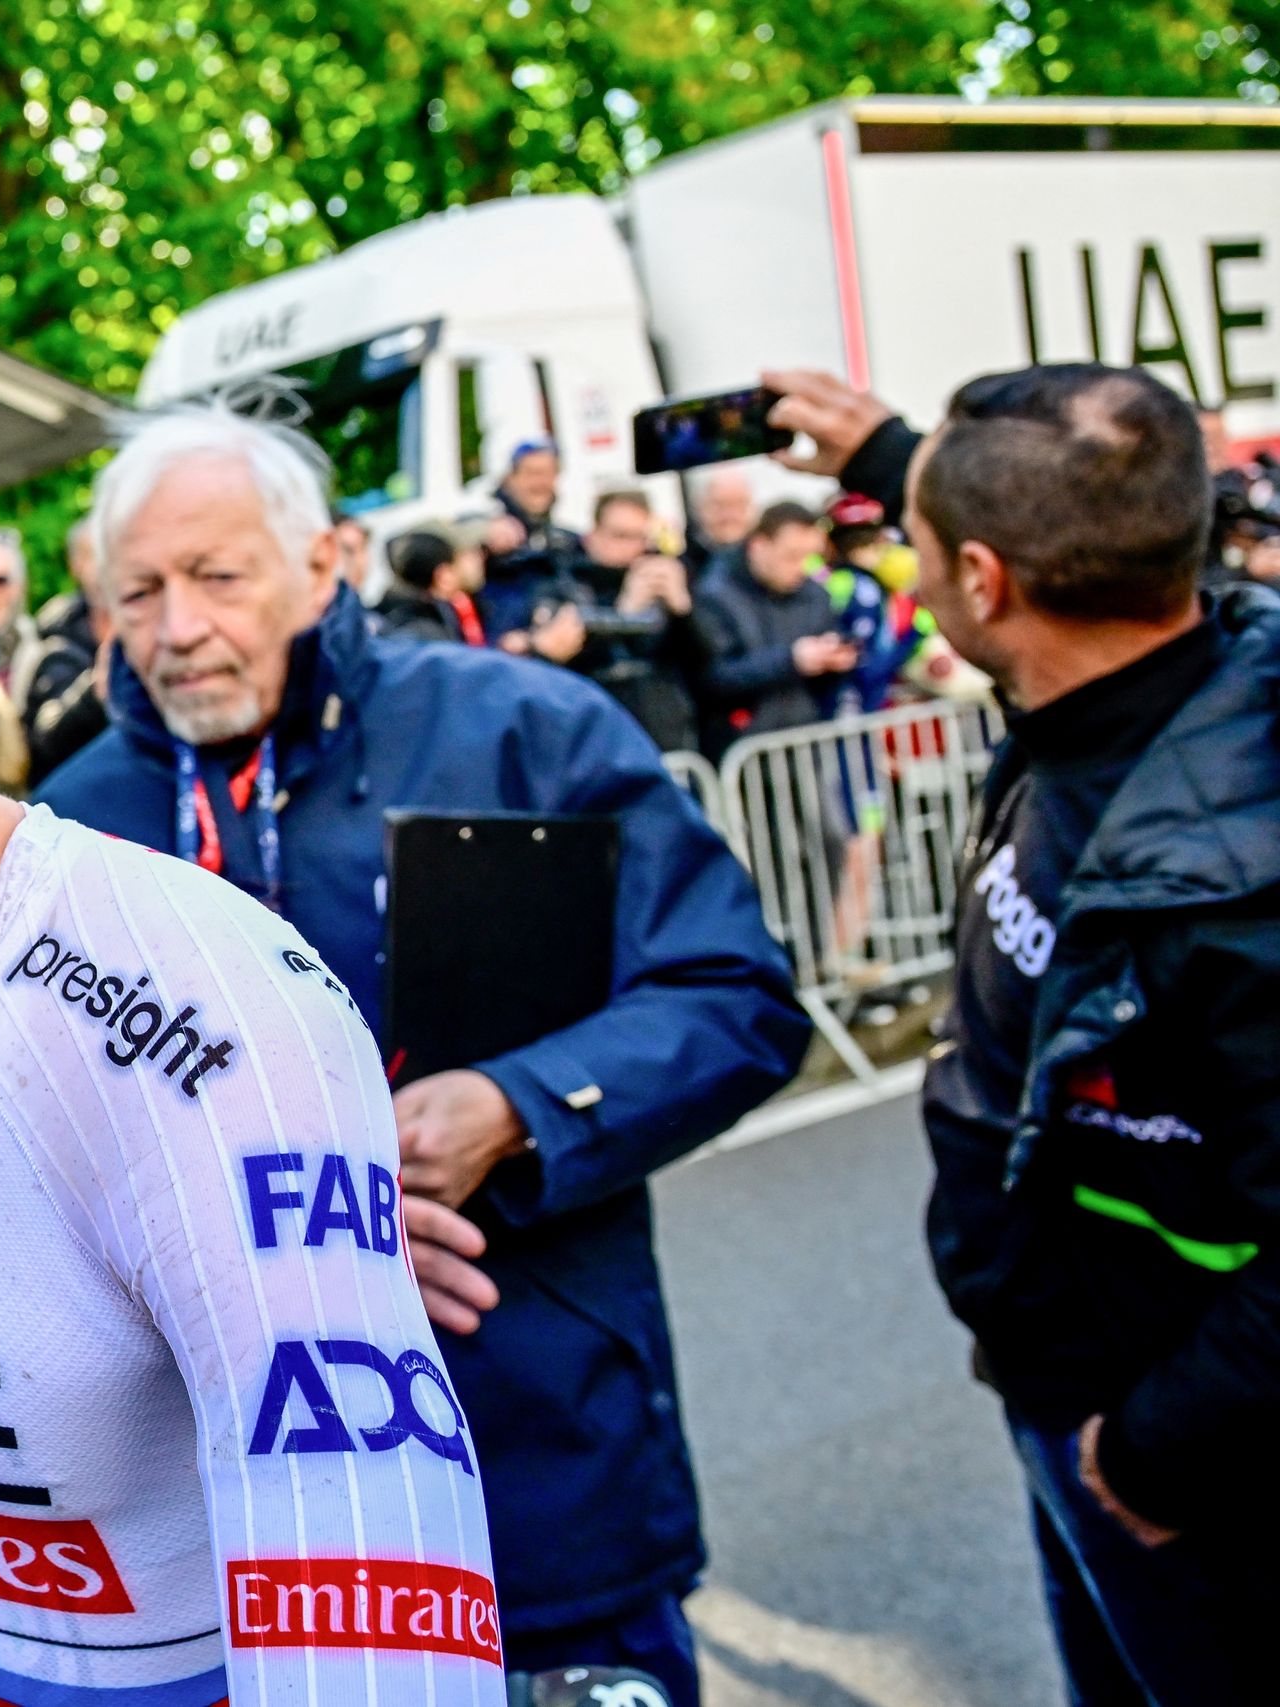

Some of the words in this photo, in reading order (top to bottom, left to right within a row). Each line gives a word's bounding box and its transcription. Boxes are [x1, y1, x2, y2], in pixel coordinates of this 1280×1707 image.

[1018, 243, 1275, 402] UAE
[6, 933, 234, 1099] presight
[234, 1569, 499, 1652] Emirates
